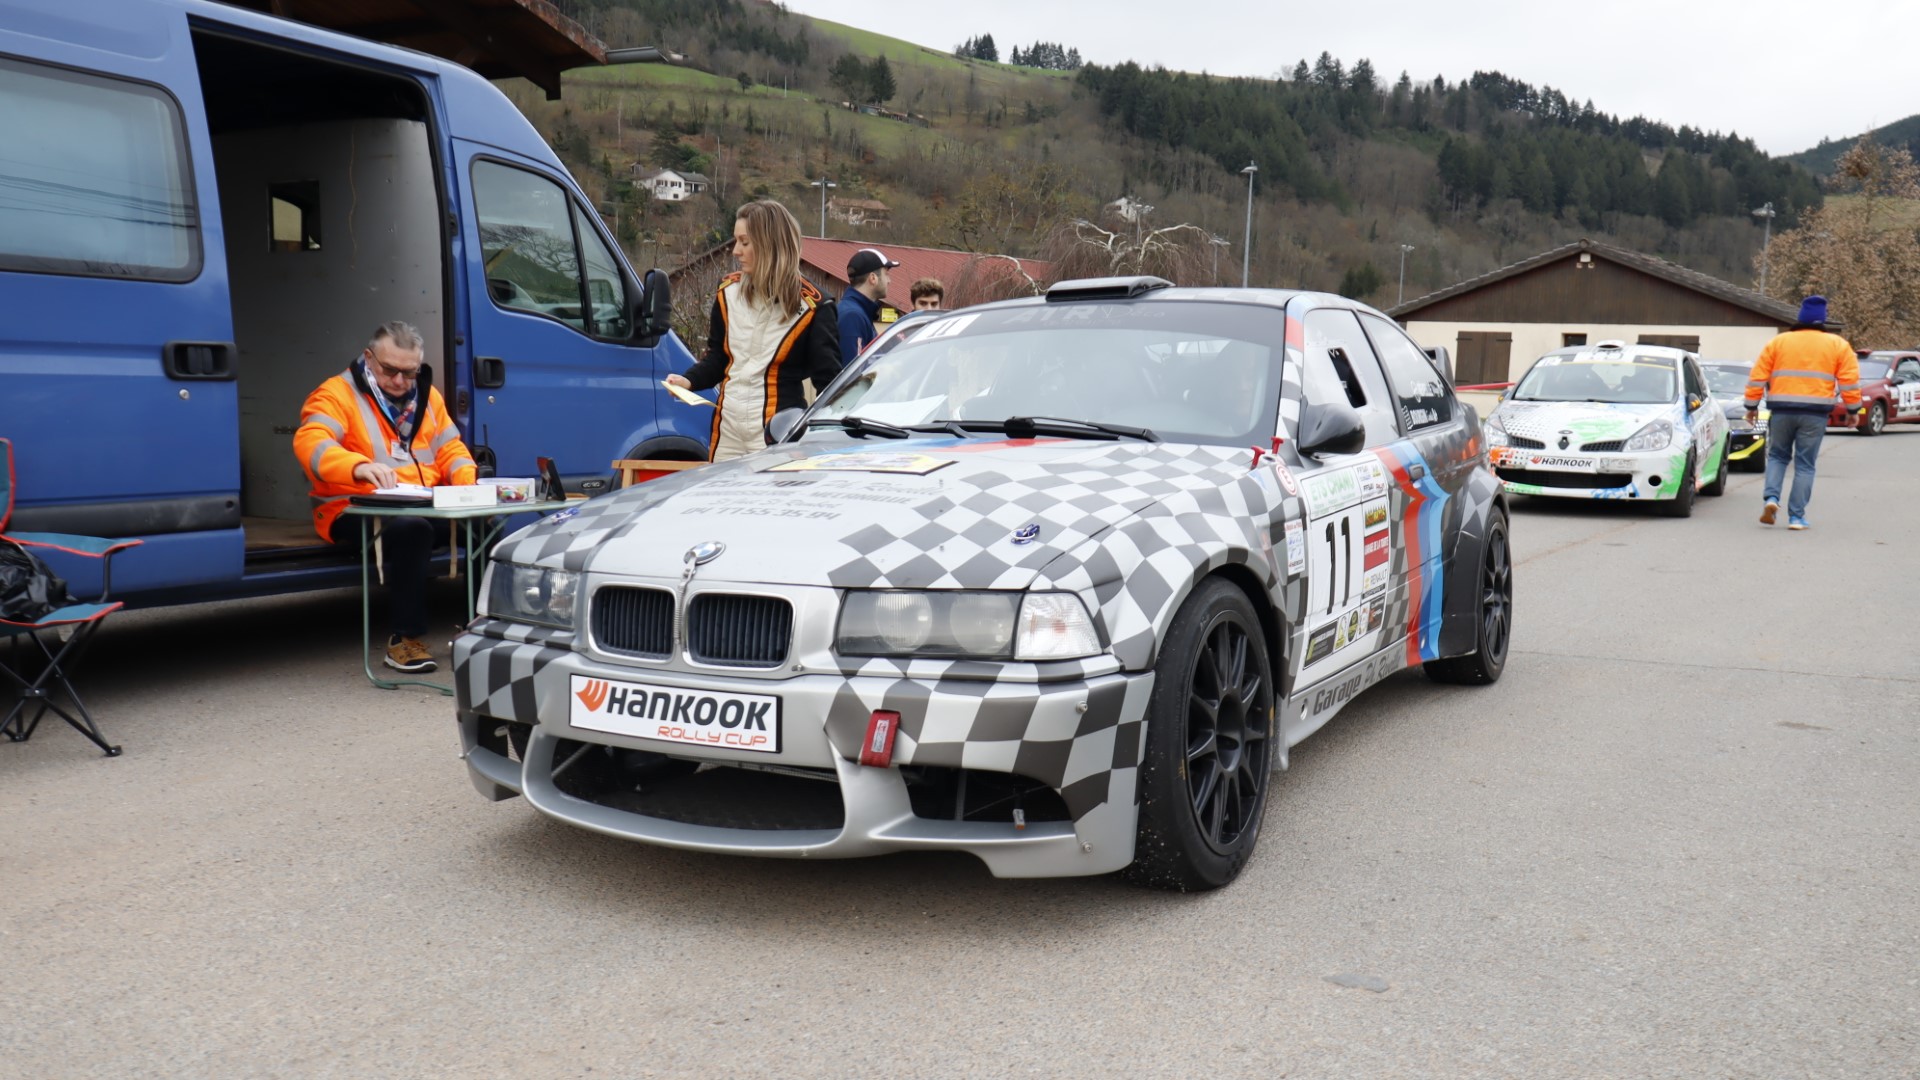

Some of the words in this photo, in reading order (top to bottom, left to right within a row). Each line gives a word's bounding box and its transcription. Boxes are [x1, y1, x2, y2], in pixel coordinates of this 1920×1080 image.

[1326, 516, 1350, 615] 11
[1313, 673, 1362, 716] Garage
[725, 733, 767, 746] CUP
